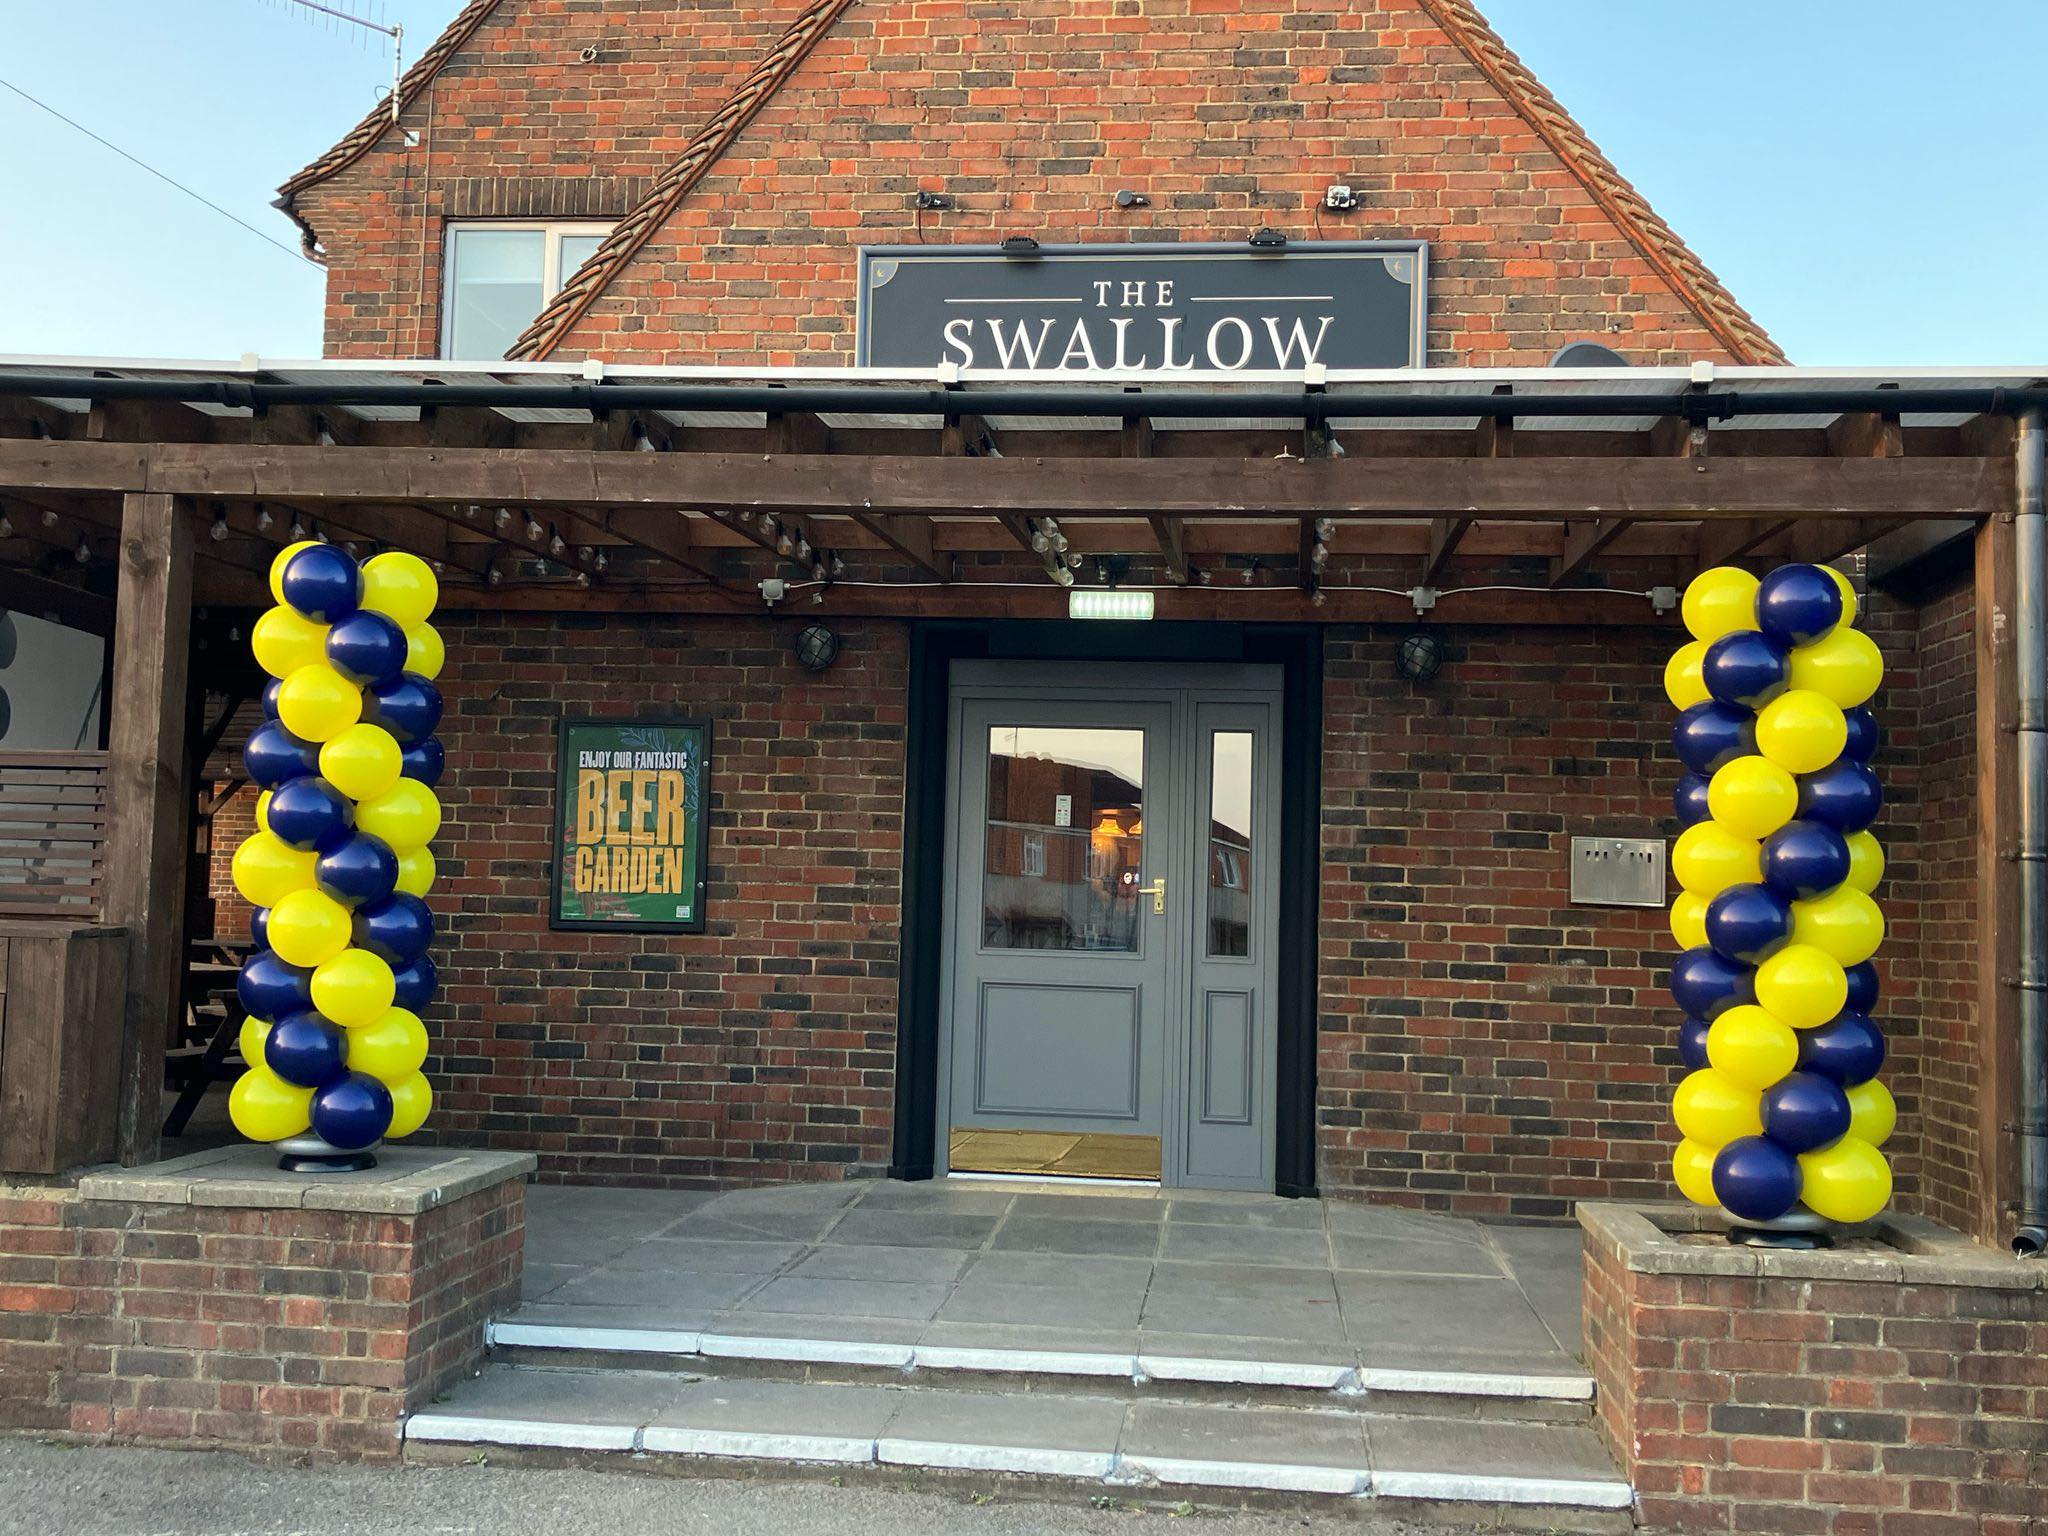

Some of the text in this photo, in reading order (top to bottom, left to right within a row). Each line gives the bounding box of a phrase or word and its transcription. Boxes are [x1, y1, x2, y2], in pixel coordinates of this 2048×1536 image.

[1093, 280, 1174, 307] THE
[943, 316, 1335, 370] SWALLOW
[579, 750, 687, 769] ENJOY OUR FANTASTIC
[577, 769, 685, 846] BEER
[575, 846, 683, 894] GARDEN
